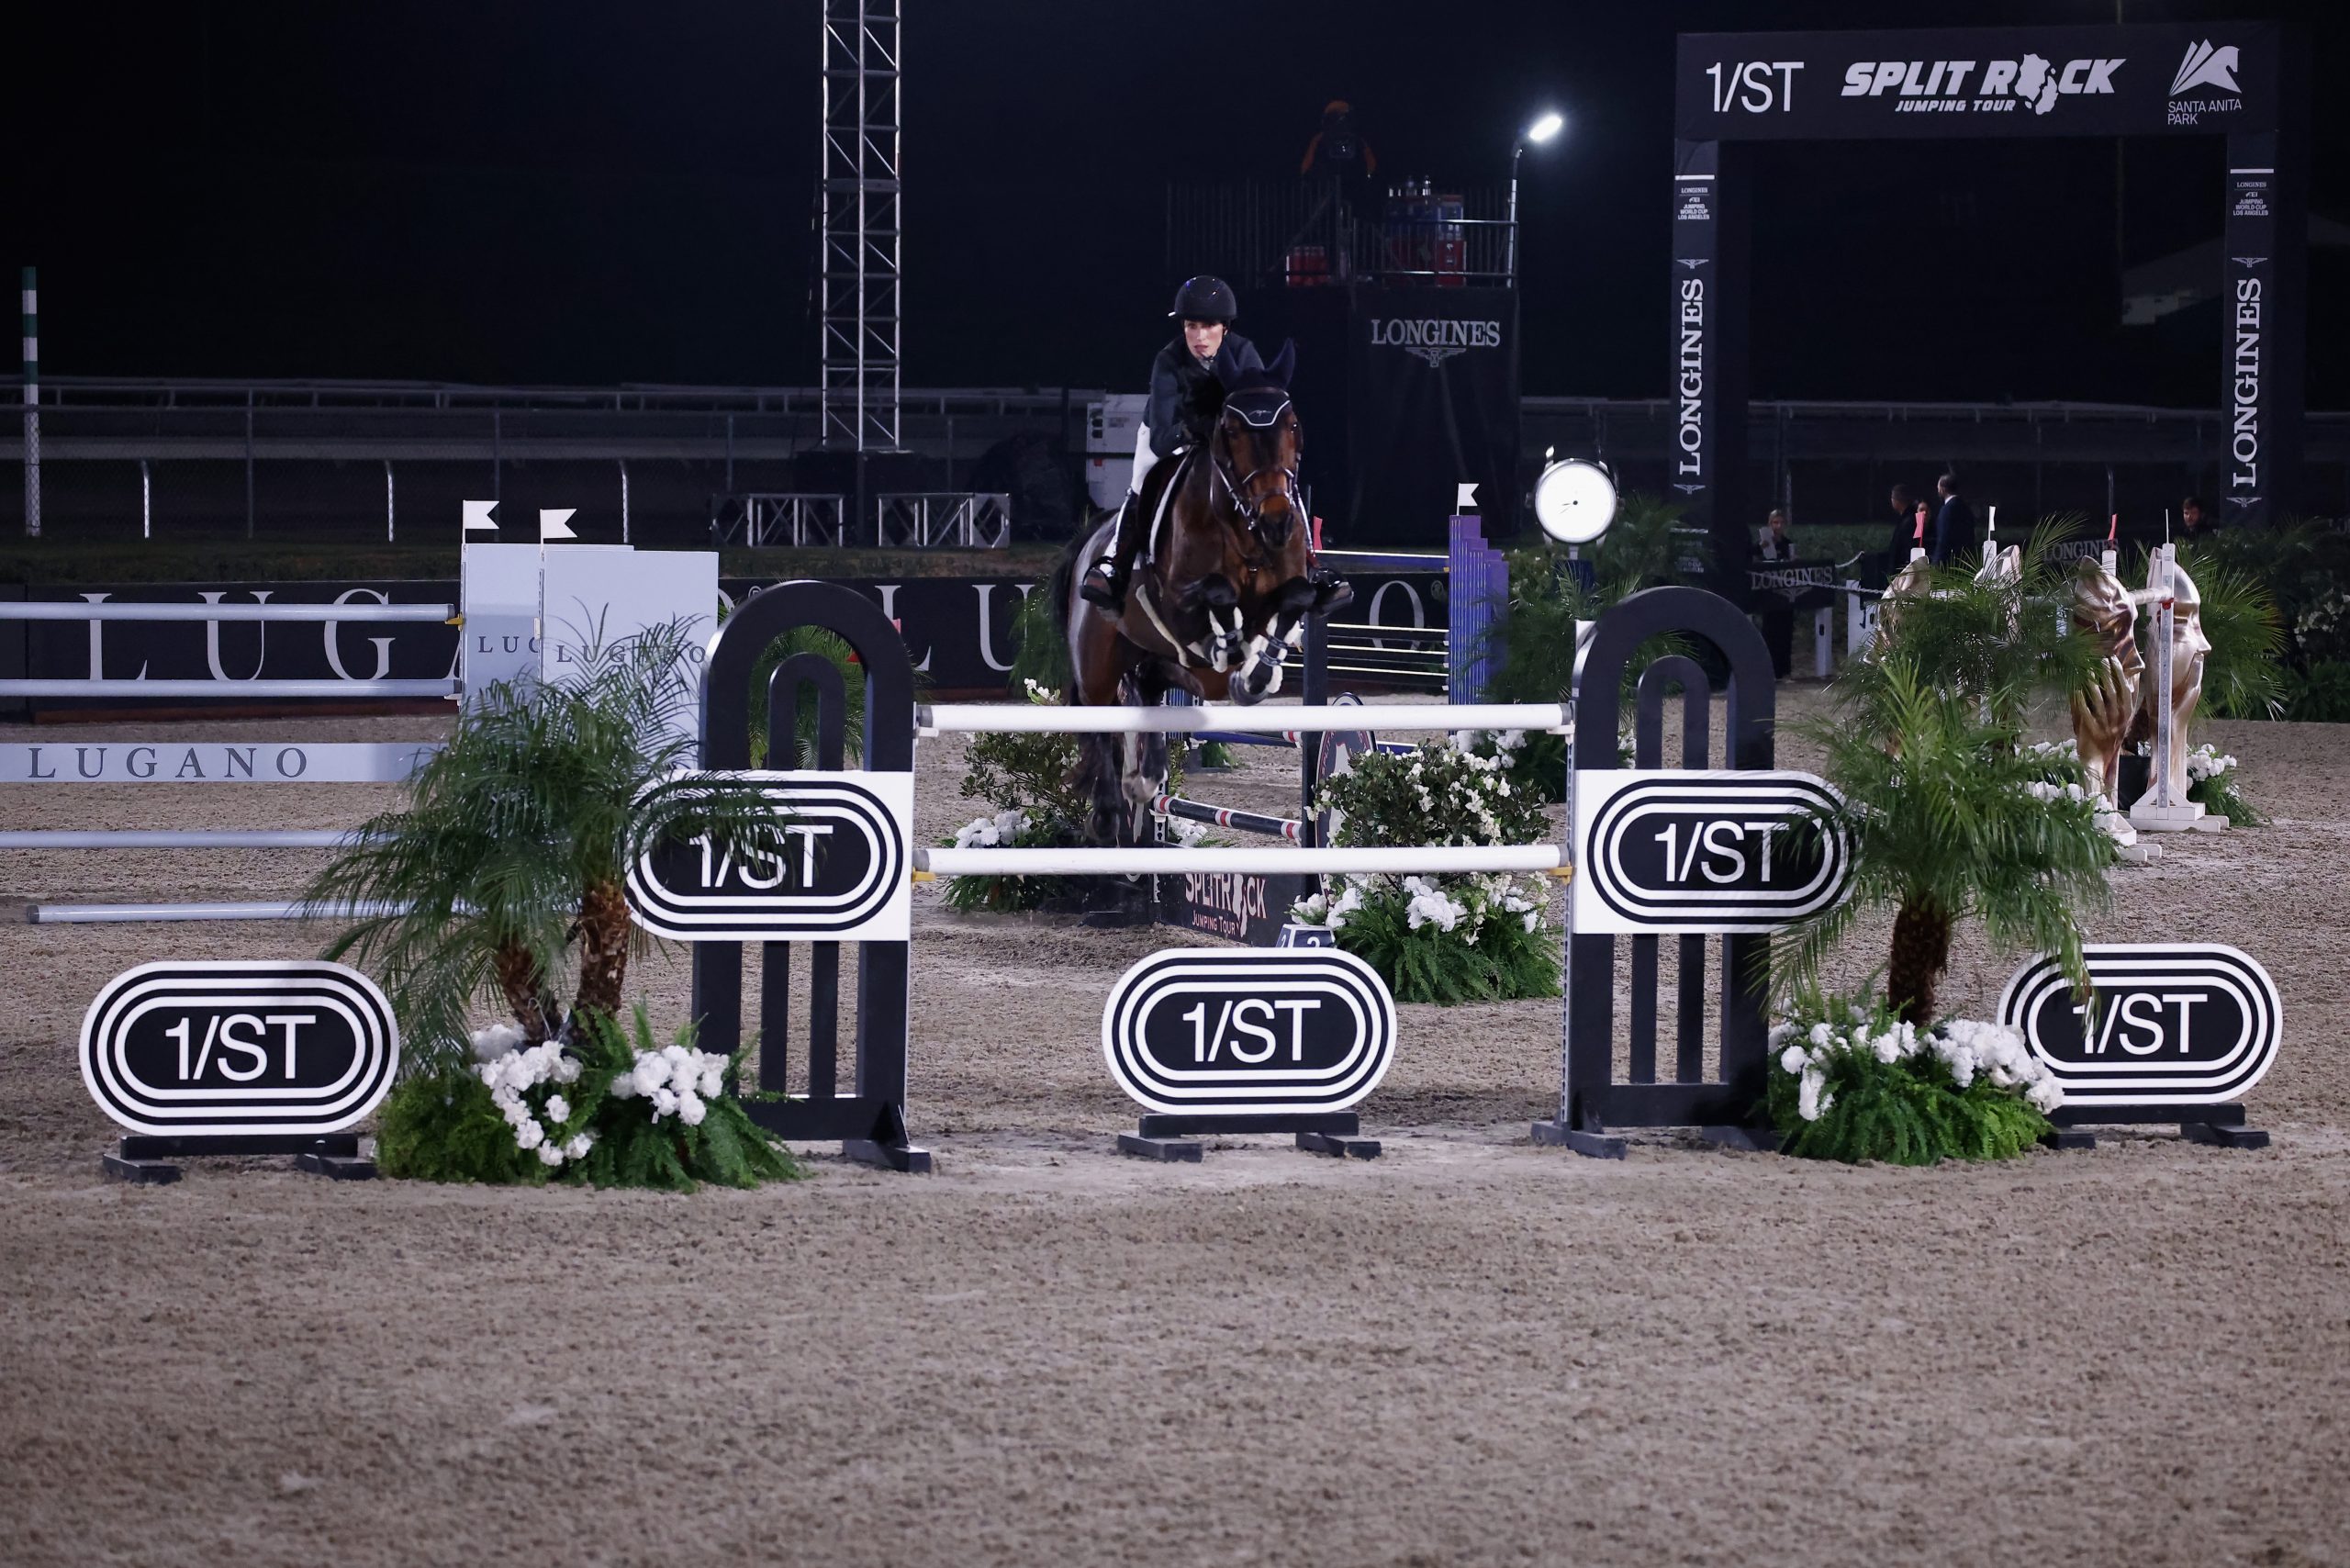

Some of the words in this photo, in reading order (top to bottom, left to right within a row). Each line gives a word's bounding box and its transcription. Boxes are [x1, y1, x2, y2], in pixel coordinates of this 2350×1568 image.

[1706, 61, 1805, 113] 1/ST
[1841, 60, 1977, 98] SPLIT
[1895, 99, 1967, 112] JUMPING
[1973, 99, 2017, 112] TOUR
[2167, 101, 2207, 113] SANTA
[2208, 99, 2243, 112] ANITA
[2167, 112, 2199, 125] PARK
[1371, 319, 1502, 348] LONGINES
[1679, 278, 1704, 476] LONGINES
[2232, 277, 2262, 487] LONGINES
[1751, 566, 1833, 590] LONGINES
[28, 746, 309, 779] LUGANO
[688, 824, 834, 890] 1/ST
[1654, 819, 1791, 883] 1/ST
[1192, 910, 1218, 931] JUMPING
[1219, 915, 1236, 935] TOUR
[1182, 999, 1321, 1063] 1/ST
[2072, 992, 2208, 1055] 1/ST
[164, 1014, 317, 1081] 1/ST
